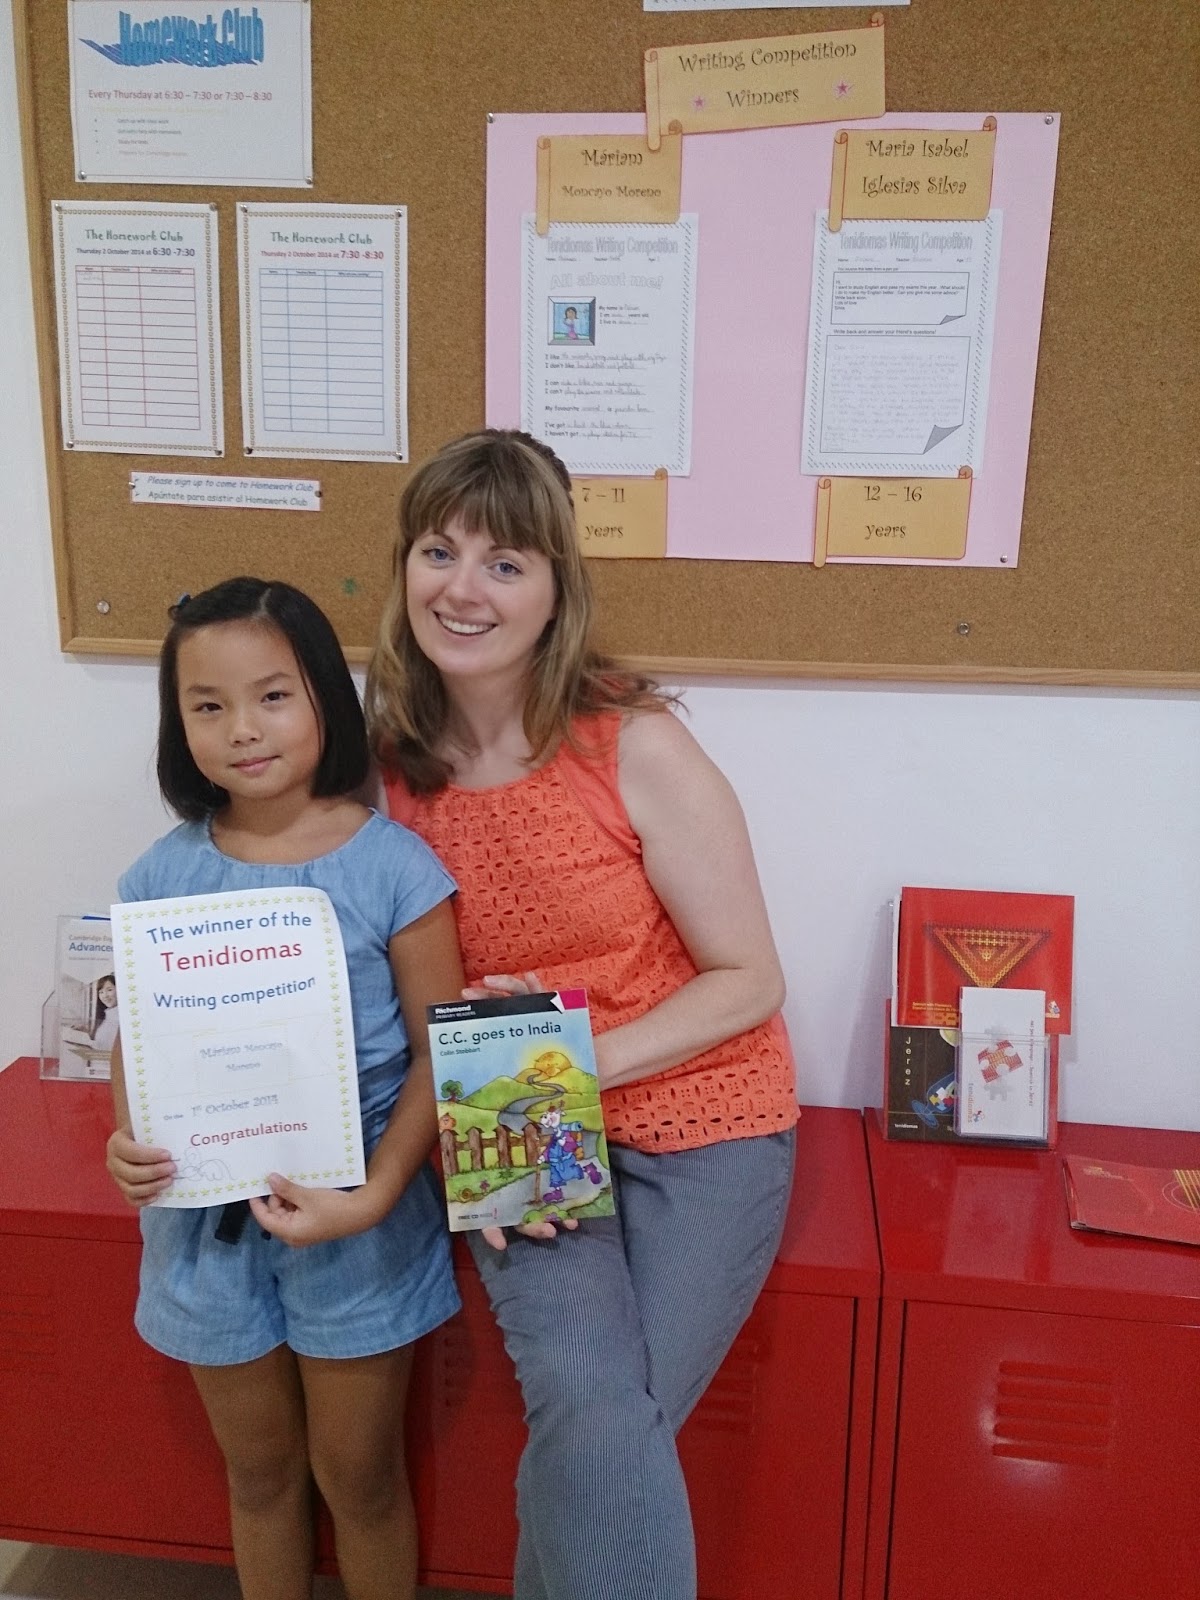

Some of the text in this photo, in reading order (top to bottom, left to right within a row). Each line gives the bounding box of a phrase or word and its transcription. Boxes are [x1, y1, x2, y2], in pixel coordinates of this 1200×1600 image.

[222, 7, 264, 64] Club
[678, 41, 857, 72] Writing Competition
[89, 89, 272, 101] Every Thursday at 6:30 7:30 or 7:30 8:30
[726, 88, 799, 108] Winners
[865, 138, 969, 157] Maria Isabel
[616, 185, 661, 197] Moreno
[862, 174, 967, 198] Iglesias Silva
[85, 228, 184, 242] The Homework Club
[270, 231, 373, 245] The Homework Club
[839, 231, 973, 253] Tenidiomas Writing Competition
[76, 247, 101, 255] Thursday
[152, 247, 171, 256] 6:30
[261, 250, 287, 259] Thursday
[340, 250, 360, 259] 7:30
[595, 236, 626, 255] Writing
[627, 236, 679, 256] Competition
[551, 273, 573, 290] All
[577, 271, 626, 287] about
[147, 475, 314, 492] Please sign up to come to Homework Club
[186, 493, 205, 502] para
[207, 493, 234, 502] asistir
[235, 494, 243, 502] al
[244, 494, 288, 506] Homework
[290, 497, 308, 507] Club
[582, 487, 626, 503] 7 11
[863, 485, 923, 502] 12 16
[583, 523, 625, 541] years
[864, 523, 907, 541] years
[146, 911, 312, 944] The winner of the
[160, 942, 302, 972] Tenidiomas
[153, 976, 316, 1010] Writing competition
[435, 1004, 471, 1014] Richmond
[438, 1022, 562, 1045] C.C. goes to India
[205, 1099, 250, 1114] October
[190, 1121, 308, 1146] Congratulations
